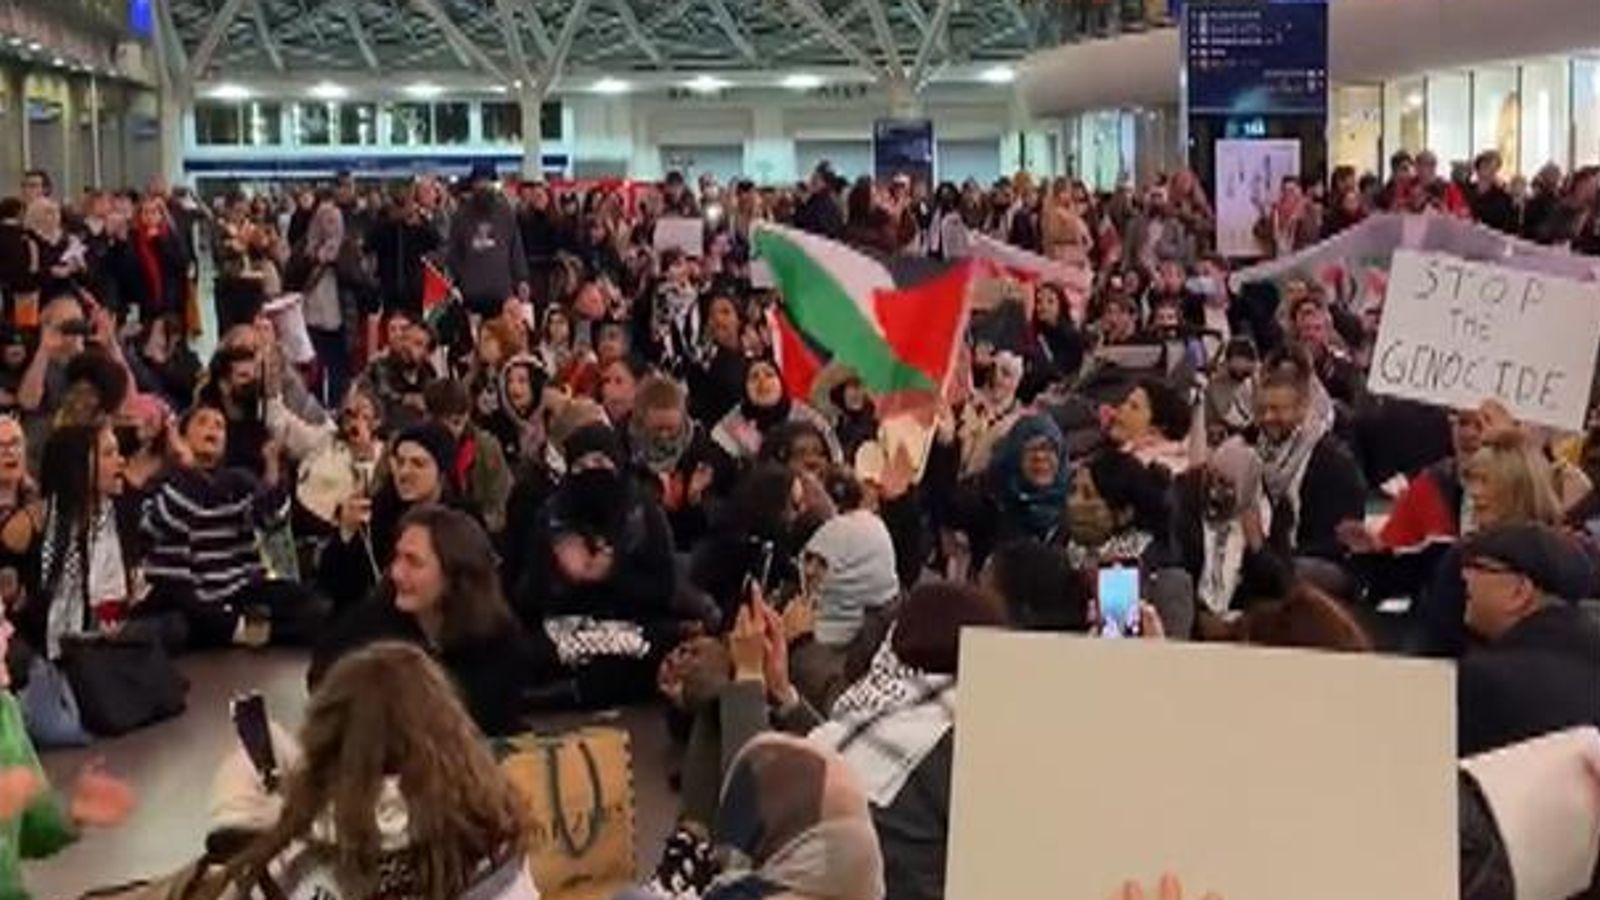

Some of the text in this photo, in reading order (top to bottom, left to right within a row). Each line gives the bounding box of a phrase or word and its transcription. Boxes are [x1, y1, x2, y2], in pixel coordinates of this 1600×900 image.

[1414, 259, 1546, 311] STOP
[1448, 308, 1492, 341] THE
[1379, 339, 1567, 409] GENOCIDE
